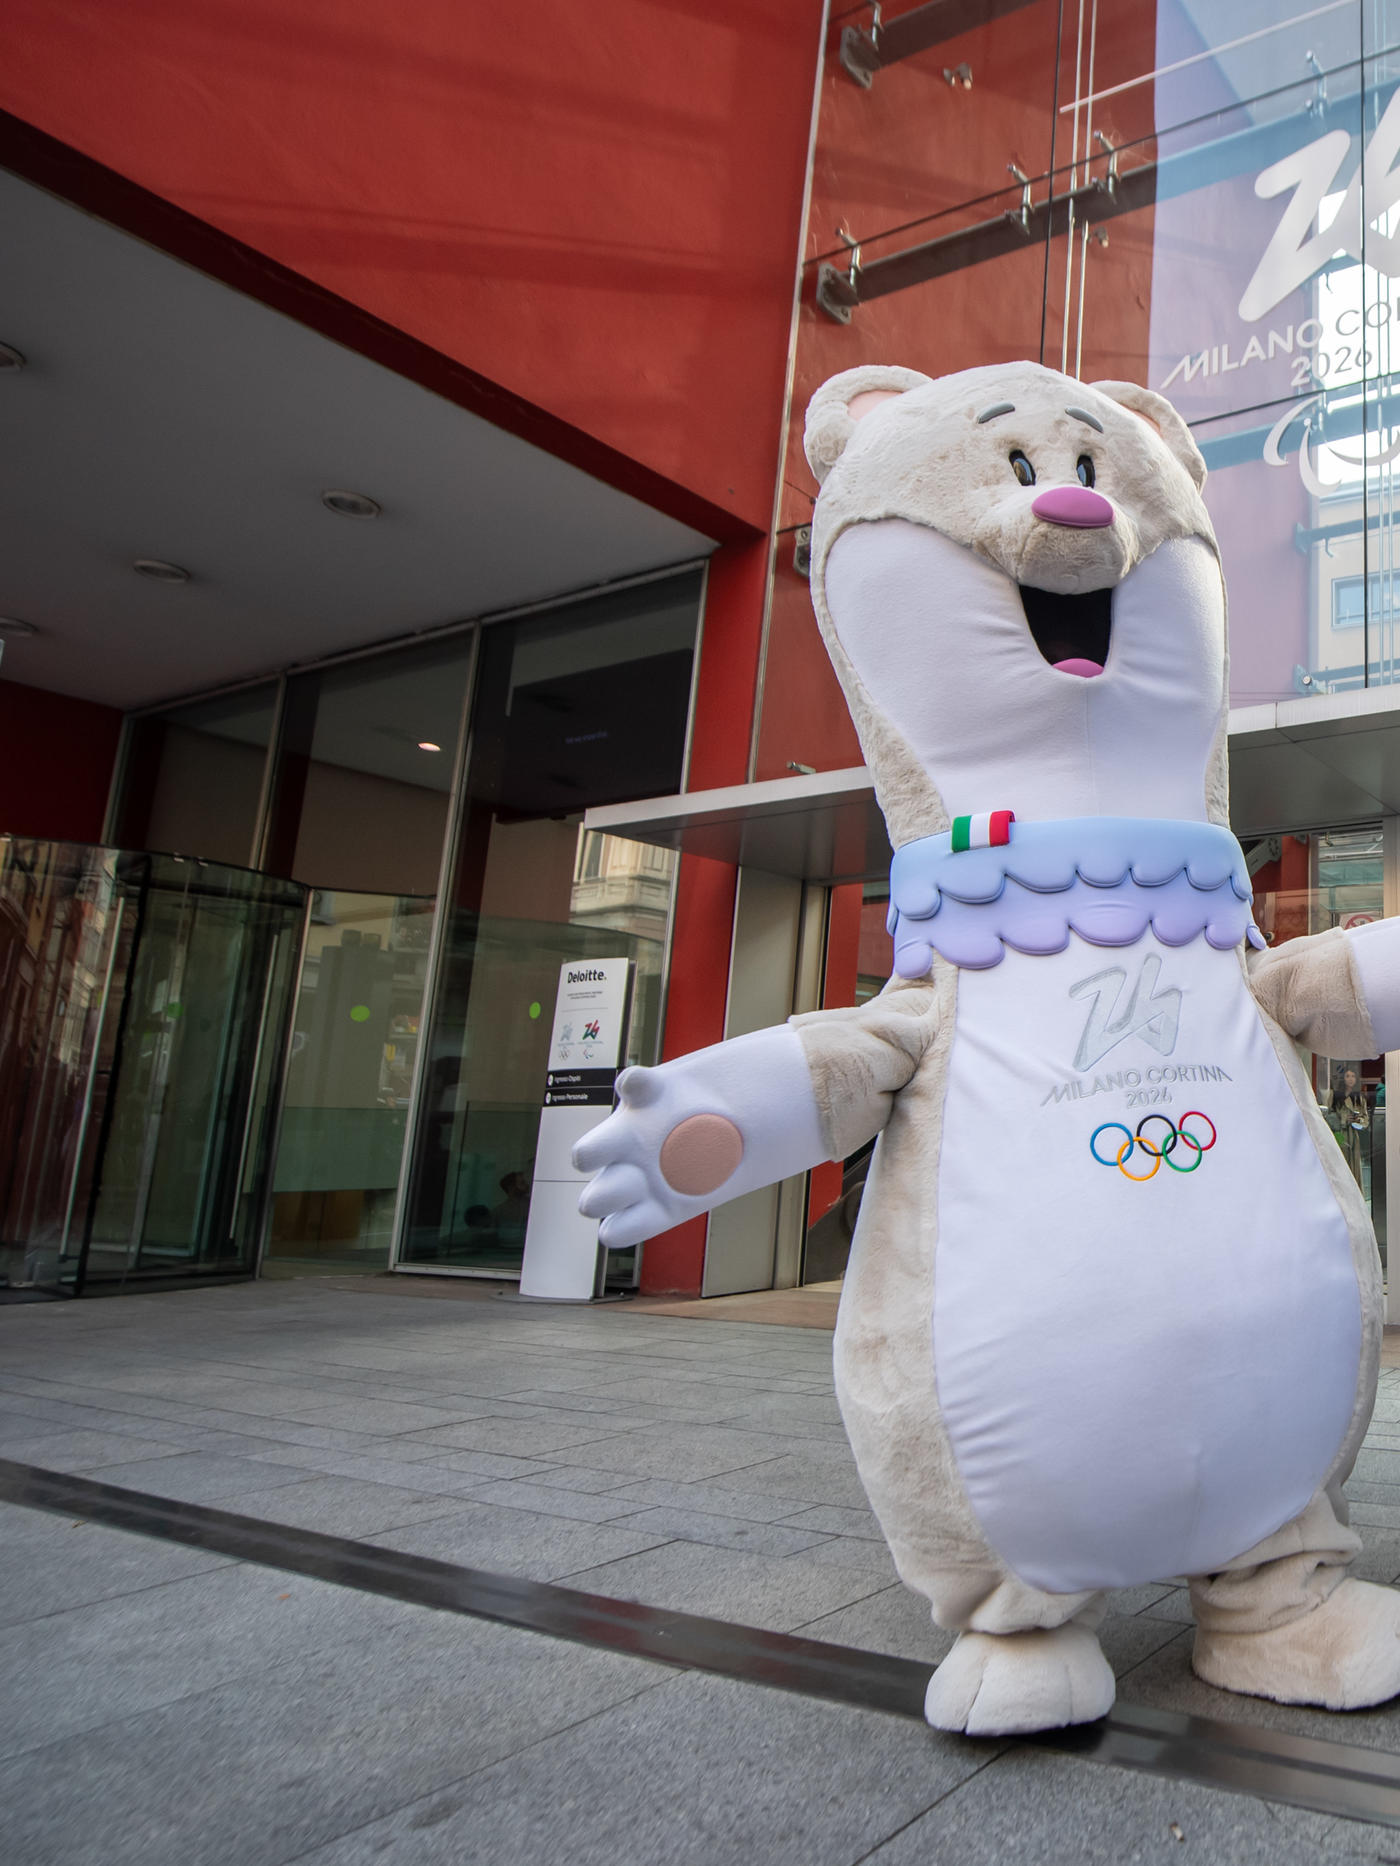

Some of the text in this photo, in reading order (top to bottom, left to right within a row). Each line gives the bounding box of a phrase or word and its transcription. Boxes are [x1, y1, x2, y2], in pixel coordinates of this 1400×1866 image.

[1160, 318, 1323, 389] MILANO
[1290, 346, 1372, 388] 2026
[1040, 1063, 1233, 1107] MILANO CORTINA
[1125, 1085, 1173, 1109] 2026
